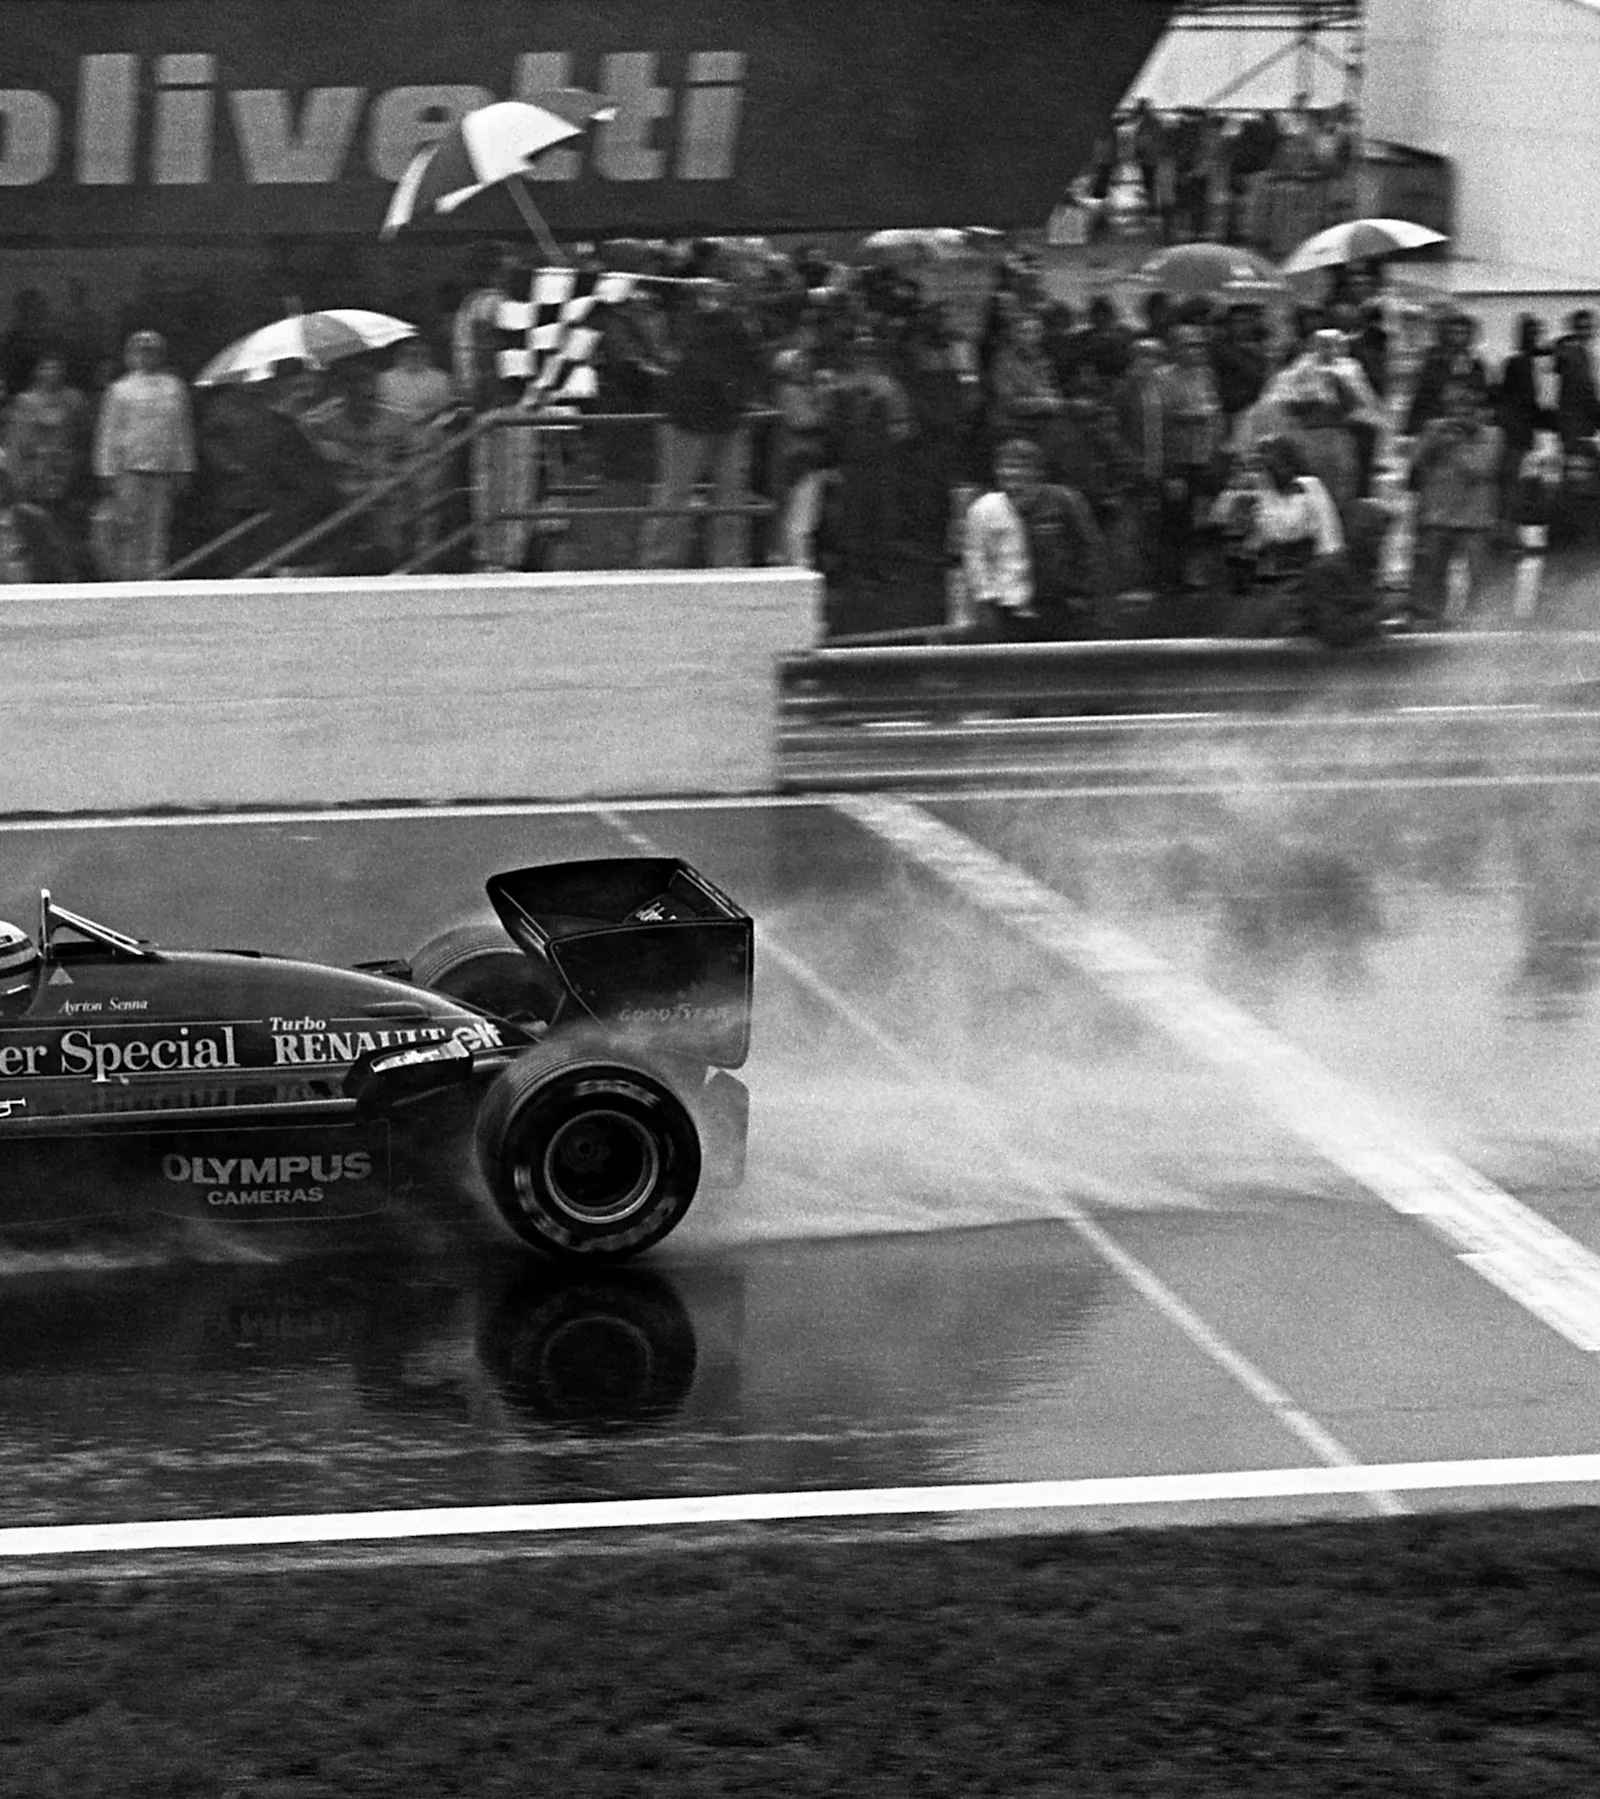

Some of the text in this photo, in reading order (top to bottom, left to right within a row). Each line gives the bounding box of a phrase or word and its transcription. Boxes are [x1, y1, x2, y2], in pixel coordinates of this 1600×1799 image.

[59, 997, 147, 1015] Ayrton Senna
[270, 1016, 326, 1031] Turbo
[451, 1021, 504, 1052] elf
[61, 1026, 240, 1083] Special
[161, 1151, 372, 1184] OLYMPUS
[207, 1186, 324, 1205] CAMERAS
